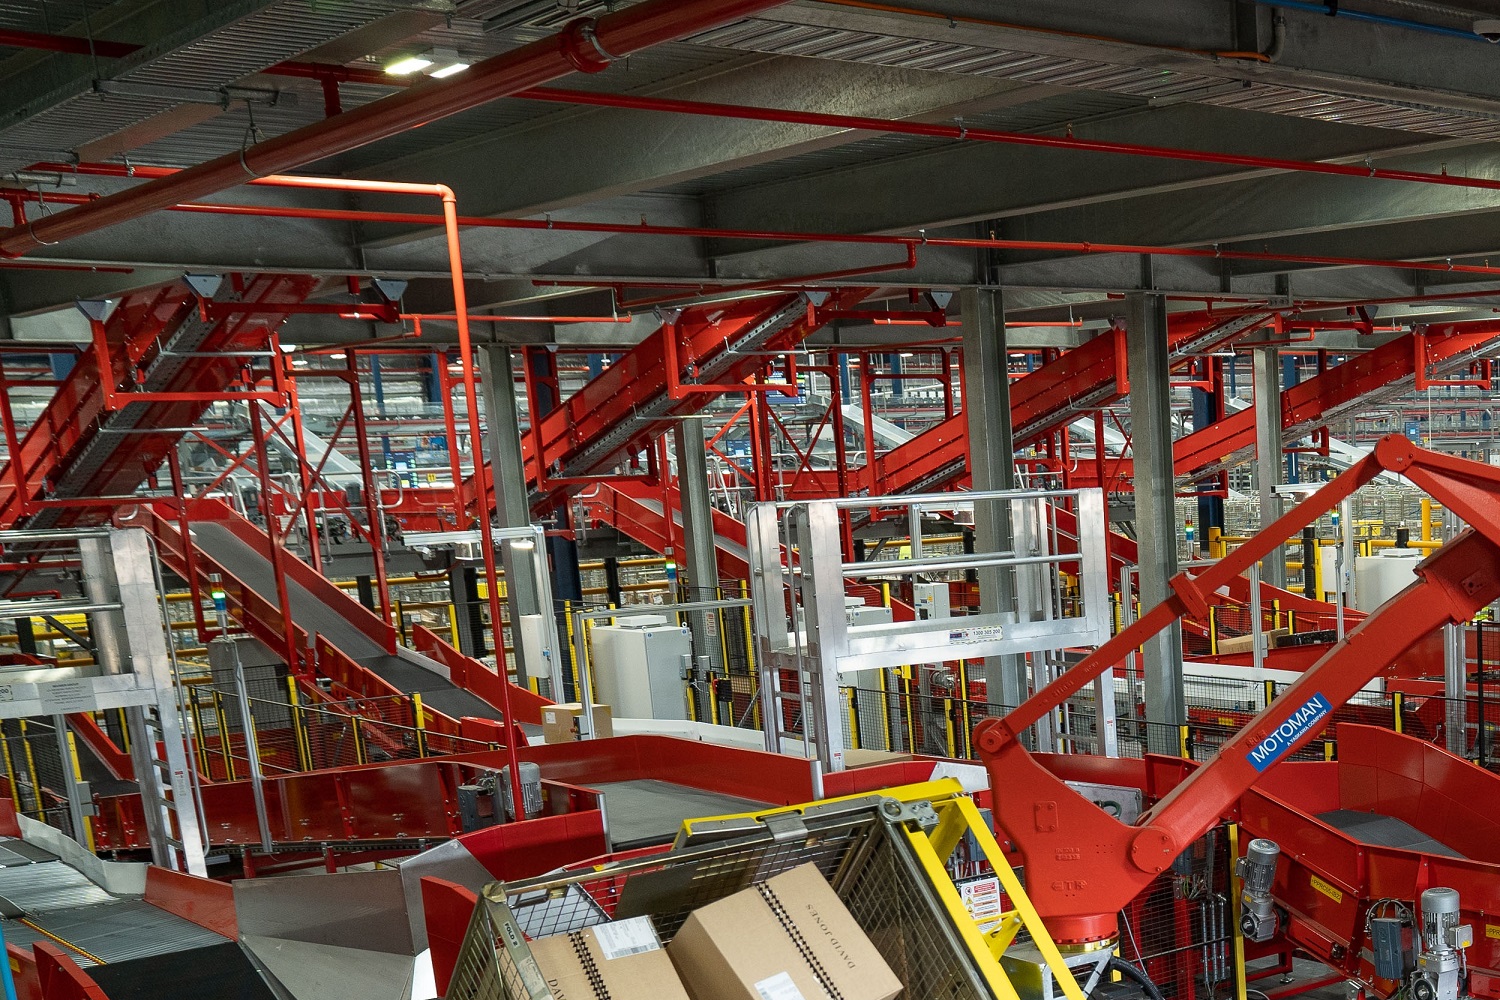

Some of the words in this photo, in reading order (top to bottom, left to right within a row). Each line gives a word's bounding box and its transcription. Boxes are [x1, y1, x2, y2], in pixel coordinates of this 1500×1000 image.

[1251, 697, 1323, 763] MOTOMAN
[504, 922, 516, 941] FOLD
[806, 903, 833, 936] JONES
[830, 938, 856, 969] DAVID
